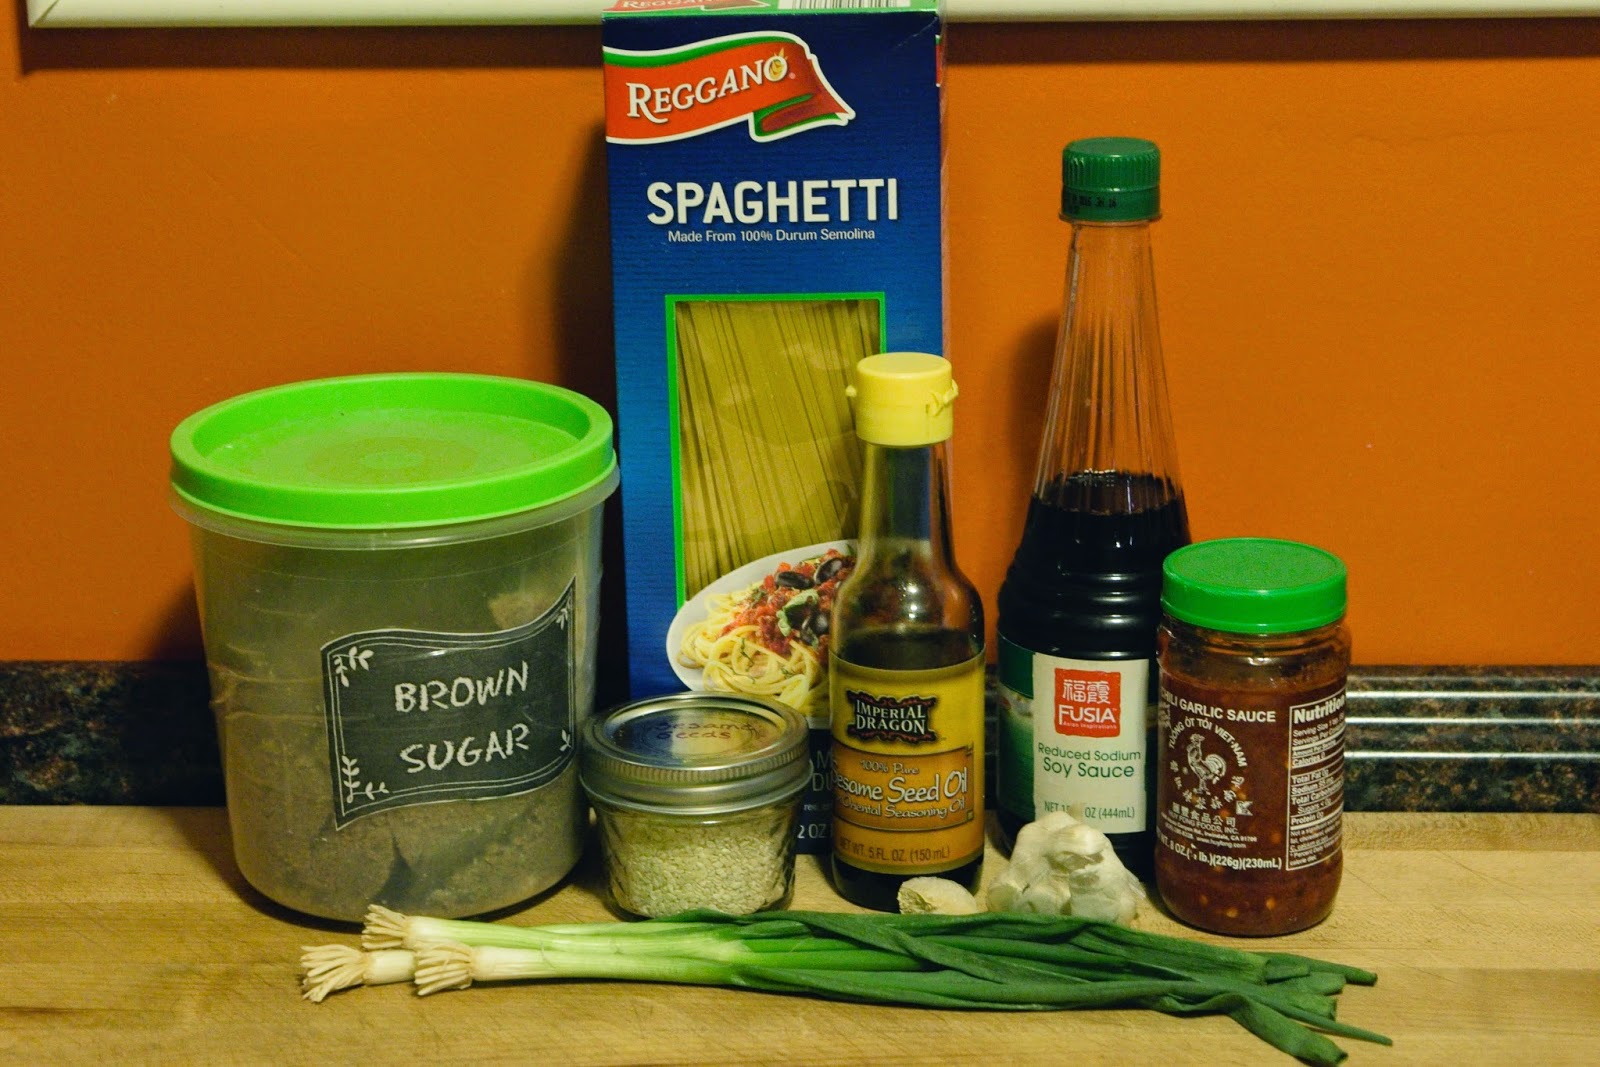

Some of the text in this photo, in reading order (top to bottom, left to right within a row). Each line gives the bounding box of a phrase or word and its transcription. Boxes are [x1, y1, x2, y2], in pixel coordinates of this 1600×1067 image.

[626, 51, 788, 124] REGGANO
[647, 178, 898, 225] SPAGHETTI
[668, 228, 875, 242] Made From 100% Durum Semolina
[395, 661, 528, 712] BROWN
[856, 699, 926, 719] IMPERIAL
[1058, 704, 1116, 725] FUSIA
[1180, 698, 1224, 720] GARLIC
[1226, 709, 1277, 723] SAUCE
[856, 714, 926, 735] DRAGON
[400, 723, 529, 773] SUGAR
[1038, 742, 1141, 761] Reduced Sodium
[860, 759, 919, 774] 100% Pure
[1043, 757, 1135, 778] Soy Sauce
[888, 773, 940, 803] Seed
[943, 766, 968, 798] Oil
[842, 795, 881, 817] Oriental
[885, 803, 947, 820] Seasoning
[949, 797, 965, 812] Oil
[1044, 800, 1059, 812] NET
[1084, 807, 1096, 818] OZ
[1098, 806, 1135, 819] (444mL)
[1224, 825, 1239, 835] INC.
